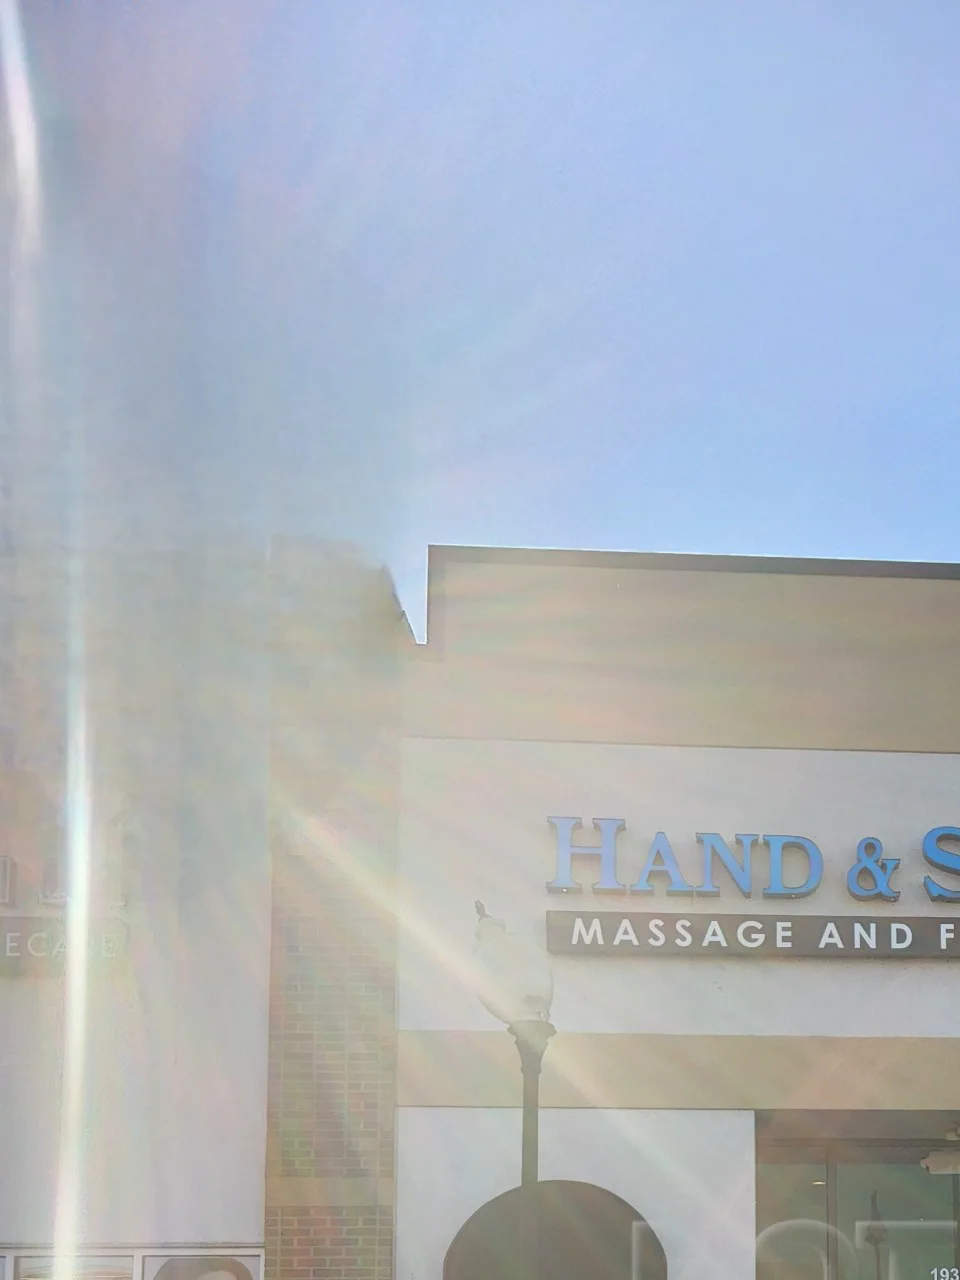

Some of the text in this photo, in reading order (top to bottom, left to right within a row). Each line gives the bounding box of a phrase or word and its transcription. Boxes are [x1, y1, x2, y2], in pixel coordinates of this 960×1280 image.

[546, 816, 824, 899] HAND
[846, 837, 901, 901] &
[571, 918, 793, 948] MASSAGE
[818, 922, 913, 949] AND
